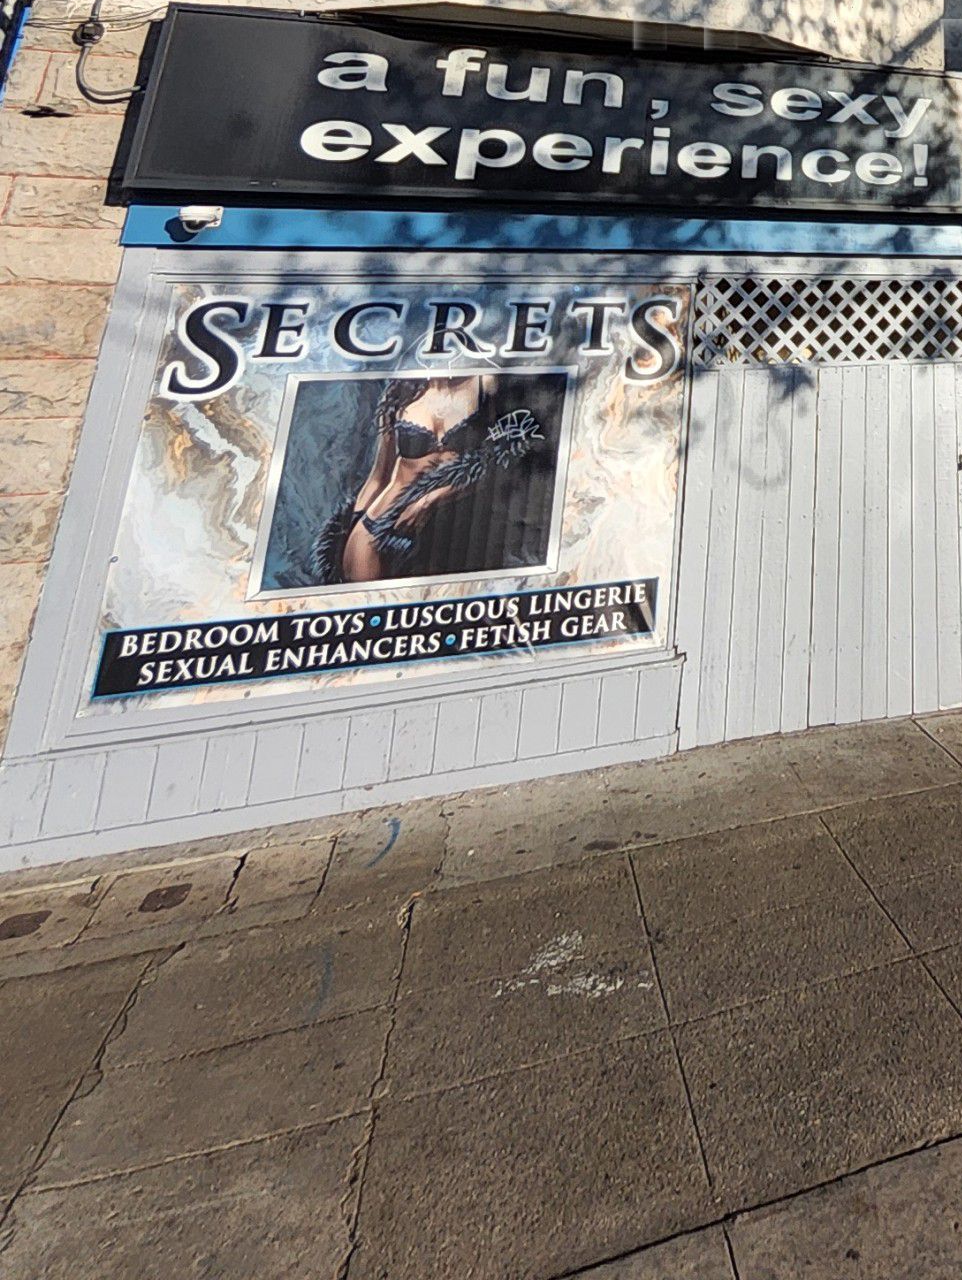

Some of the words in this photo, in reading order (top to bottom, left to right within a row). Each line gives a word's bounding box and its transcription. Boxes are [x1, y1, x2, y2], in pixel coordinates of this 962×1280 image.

[316, 51, 389, 92] a
[710, 82, 933, 138] sexy
[299, 119, 929, 188] experience!
[163, 296, 681, 398] SECRETS
[118, 623, 279, 659] BEDROOM
[290, 611, 366, 641] TOYS
[383, 596, 520, 632] LUSCIOUS
[529, 583, 647, 616] LINGERIE
[136, 653, 254, 687] SEXUAL
[263, 631, 441, 672] ENHANCERS
[459, 619, 551, 651] FETISH
[560, 611, 628, 638] GEAR
